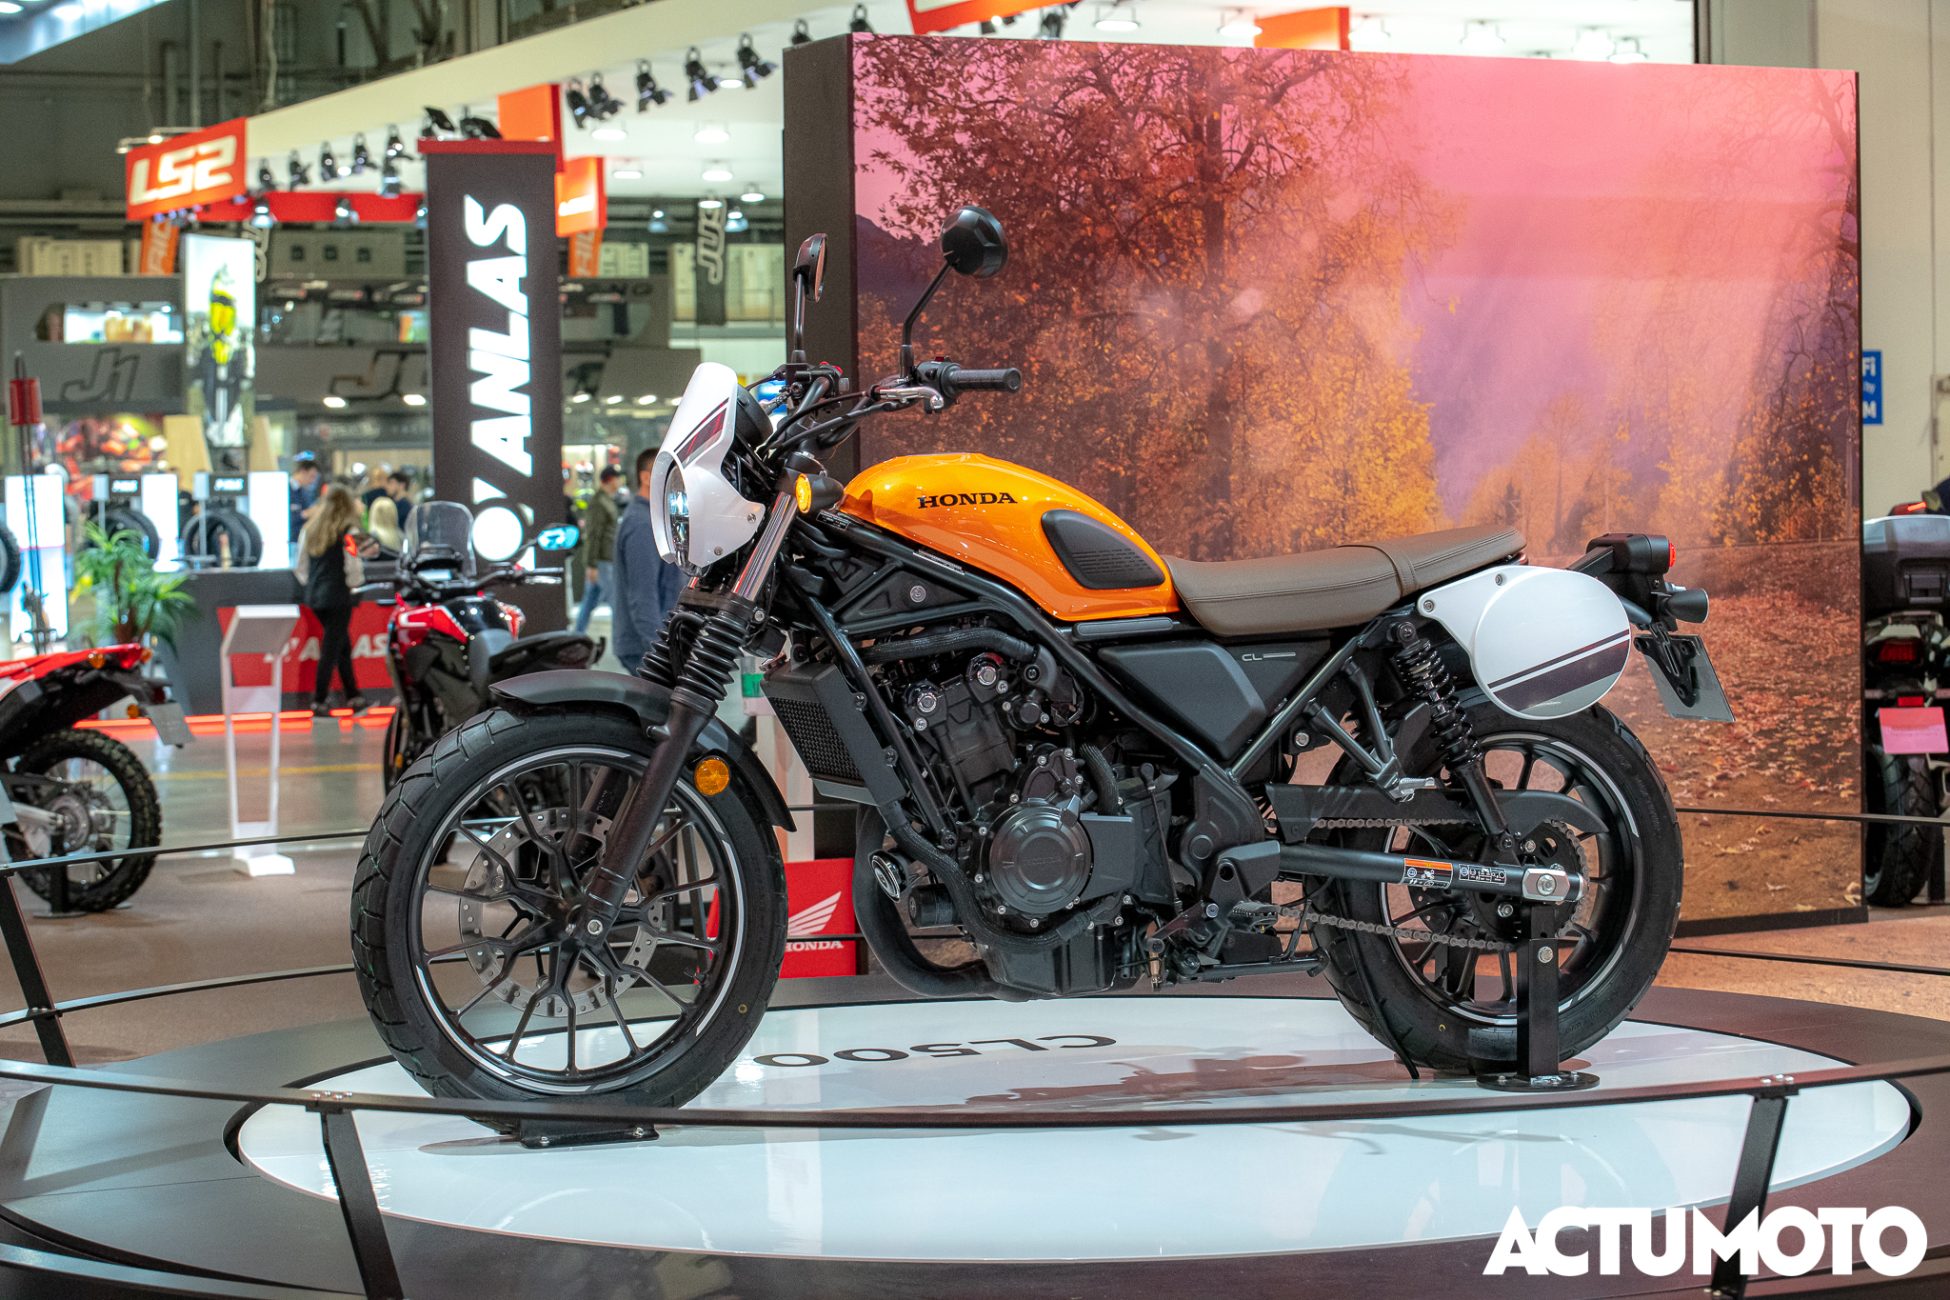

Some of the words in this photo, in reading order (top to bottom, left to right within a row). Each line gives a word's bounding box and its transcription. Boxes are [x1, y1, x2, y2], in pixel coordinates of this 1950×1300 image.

[129, 135, 237, 205] LS2
[917, 492, 1018, 510] HONDA
[1241, 653, 1263, 662] CL
[753, 1034, 1117, 1067] CL500
